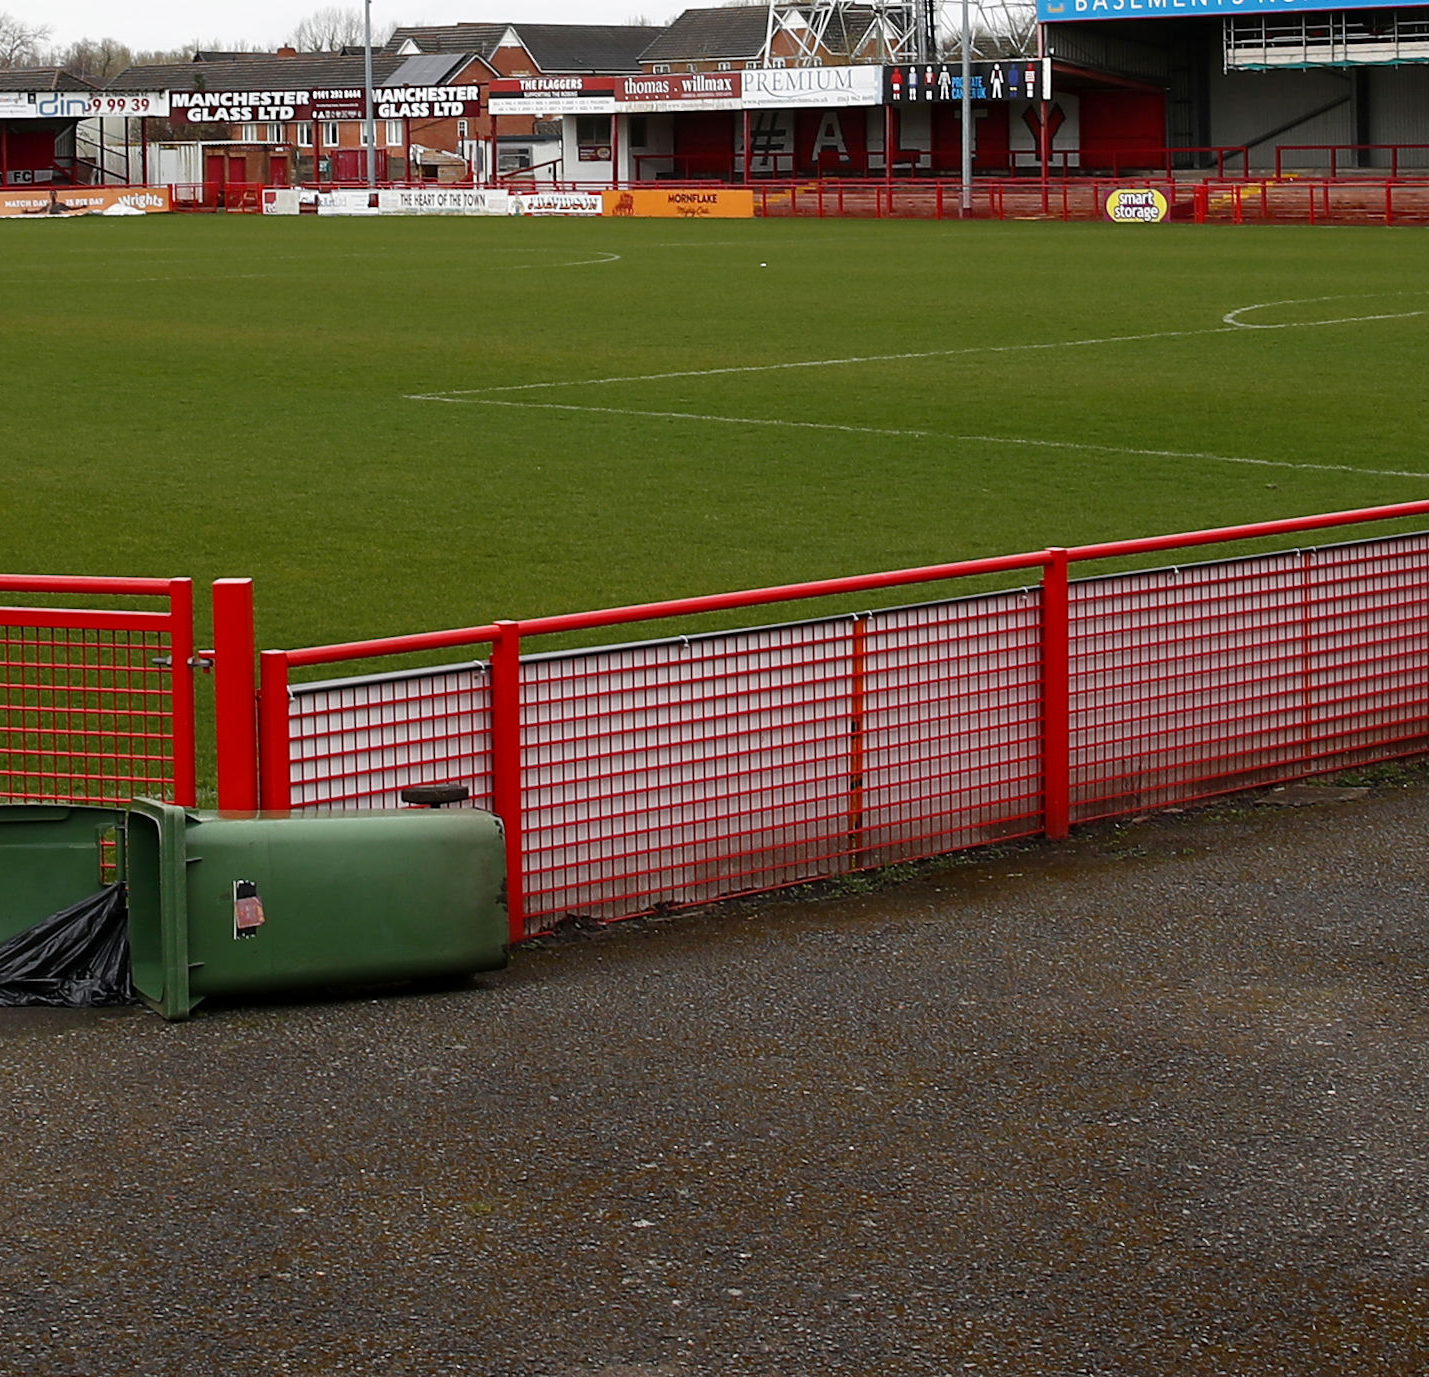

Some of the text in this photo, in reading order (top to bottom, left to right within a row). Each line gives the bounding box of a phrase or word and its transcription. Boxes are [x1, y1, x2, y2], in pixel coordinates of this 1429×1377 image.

[519, 78, 583, 91] THE FLAGGERS
[623, 75, 733, 95] thomas willmax
[743, 69, 854, 93] PREMIUM
[172, 91, 310, 107] MANCHESTER
[372, 85, 479, 103] MANCHESTER
[39, 93, 86, 115] din
[107, 98, 126, 112] 99
[131, 98, 150, 111] 39
[378, 102, 465, 118] GLASS LTD
[187, 106, 295, 122] GLASS LTD
[13, 171, 32, 183] FC
[118, 193, 163, 208] Wrights
[400, 194, 486, 207] THE HEART OF THE TOWN
[667, 193, 717, 204] MORNFLAKE
[1119, 191, 1154, 204] smart
[1115, 205, 1159, 222] storage
